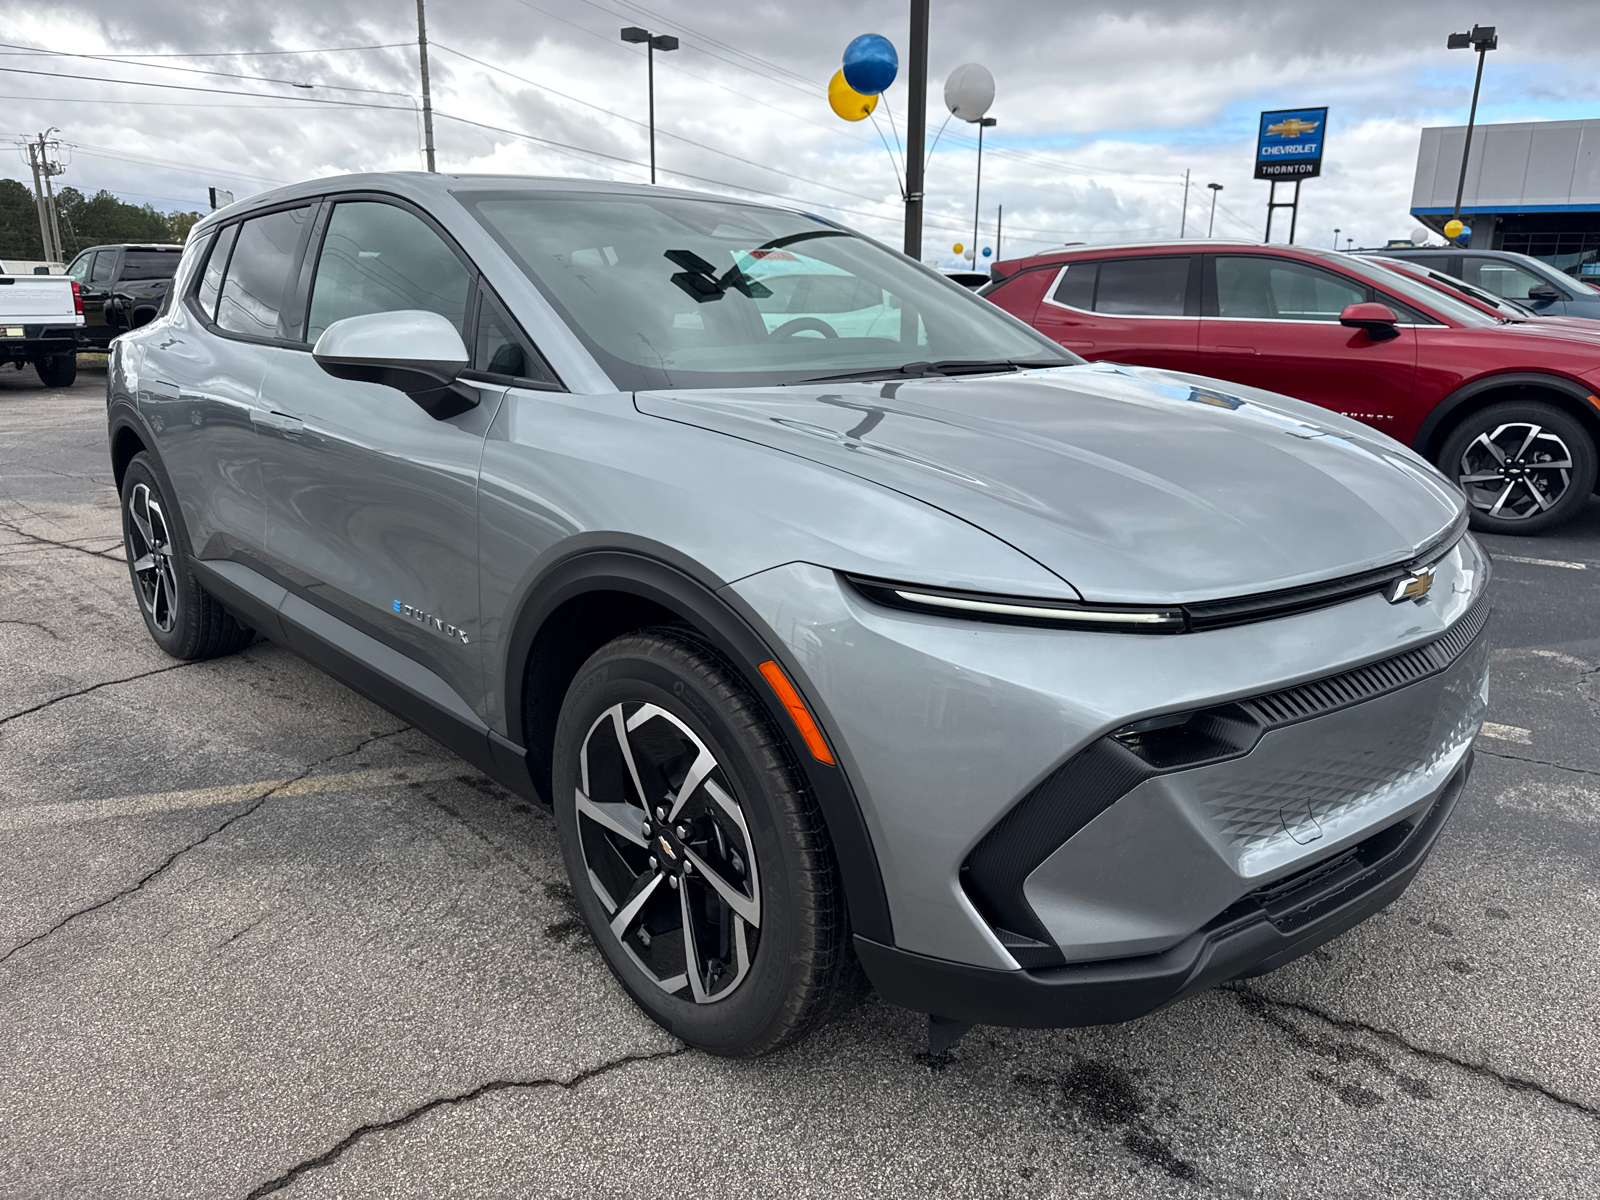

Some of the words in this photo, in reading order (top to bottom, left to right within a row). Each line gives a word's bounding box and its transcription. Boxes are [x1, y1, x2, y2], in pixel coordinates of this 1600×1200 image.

[1261, 143, 1317, 155] CHEVROLET
[1261, 164, 1313, 174] THORNTON
[393, 599, 469, 644] EQUINOX
